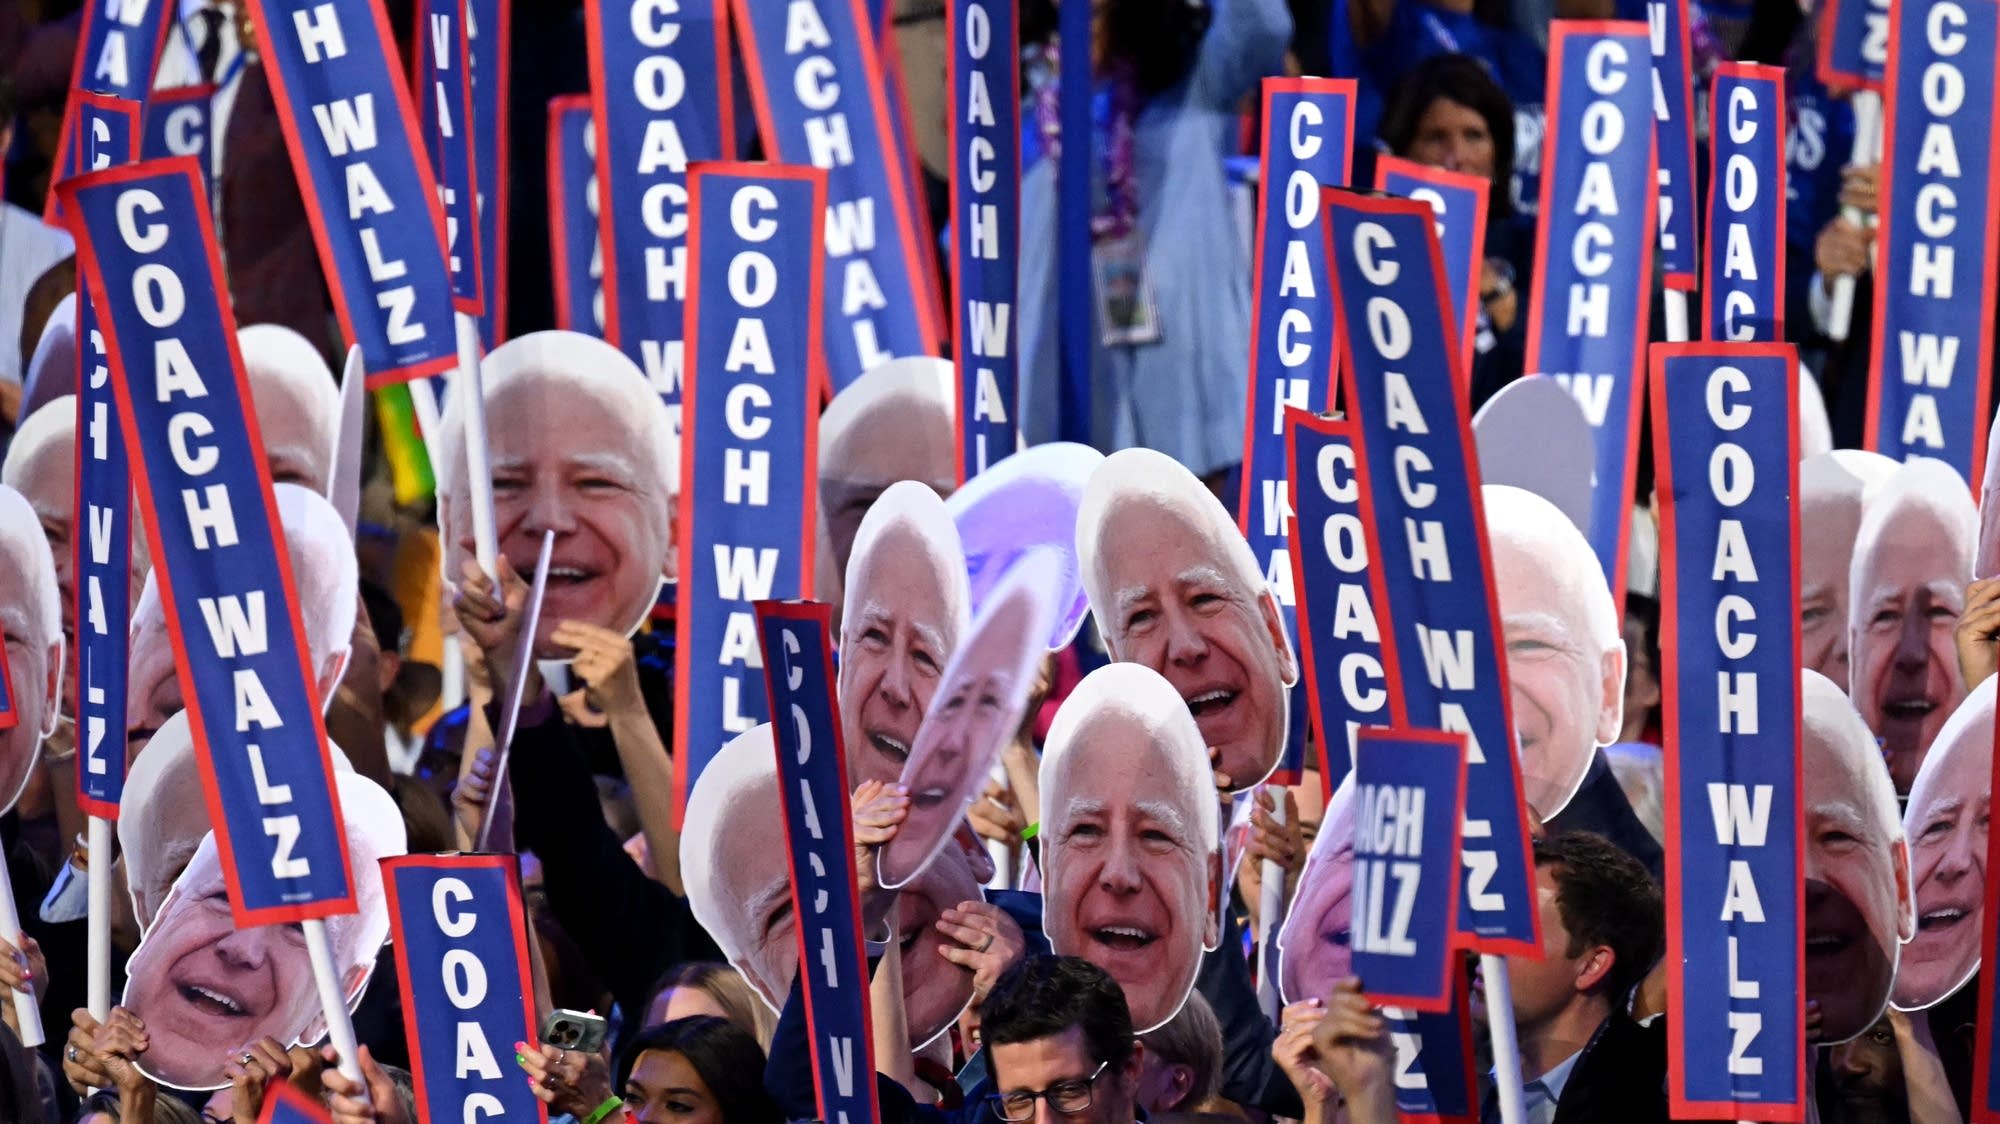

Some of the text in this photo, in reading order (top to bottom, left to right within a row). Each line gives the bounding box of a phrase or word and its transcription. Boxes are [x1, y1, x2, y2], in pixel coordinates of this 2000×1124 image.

[312, 93, 426, 346] WALZ
[630, 0, 688, 302] COACH
[785, 0, 894, 374] ACH WAL
[966, 3, 1010, 477] OACH WAL
[1567, 40, 1628, 337] COACH
[1725, 86, 1758, 341] COAC
[1900, 1, 1968, 450] COACH WA
[713, 186, 780, 734] COACH WAL
[1263, 101, 1323, 606] COACH WA
[1353, 221, 1452, 581] COACH
[116, 189, 239, 550] COACH
[199, 591, 310, 879] WALZ
[1705, 366, 1759, 735] COACH
[1354, 784, 1426, 856] ACH
[1707, 783, 1773, 1075] WALZ
[432, 877, 505, 1124] COAC
